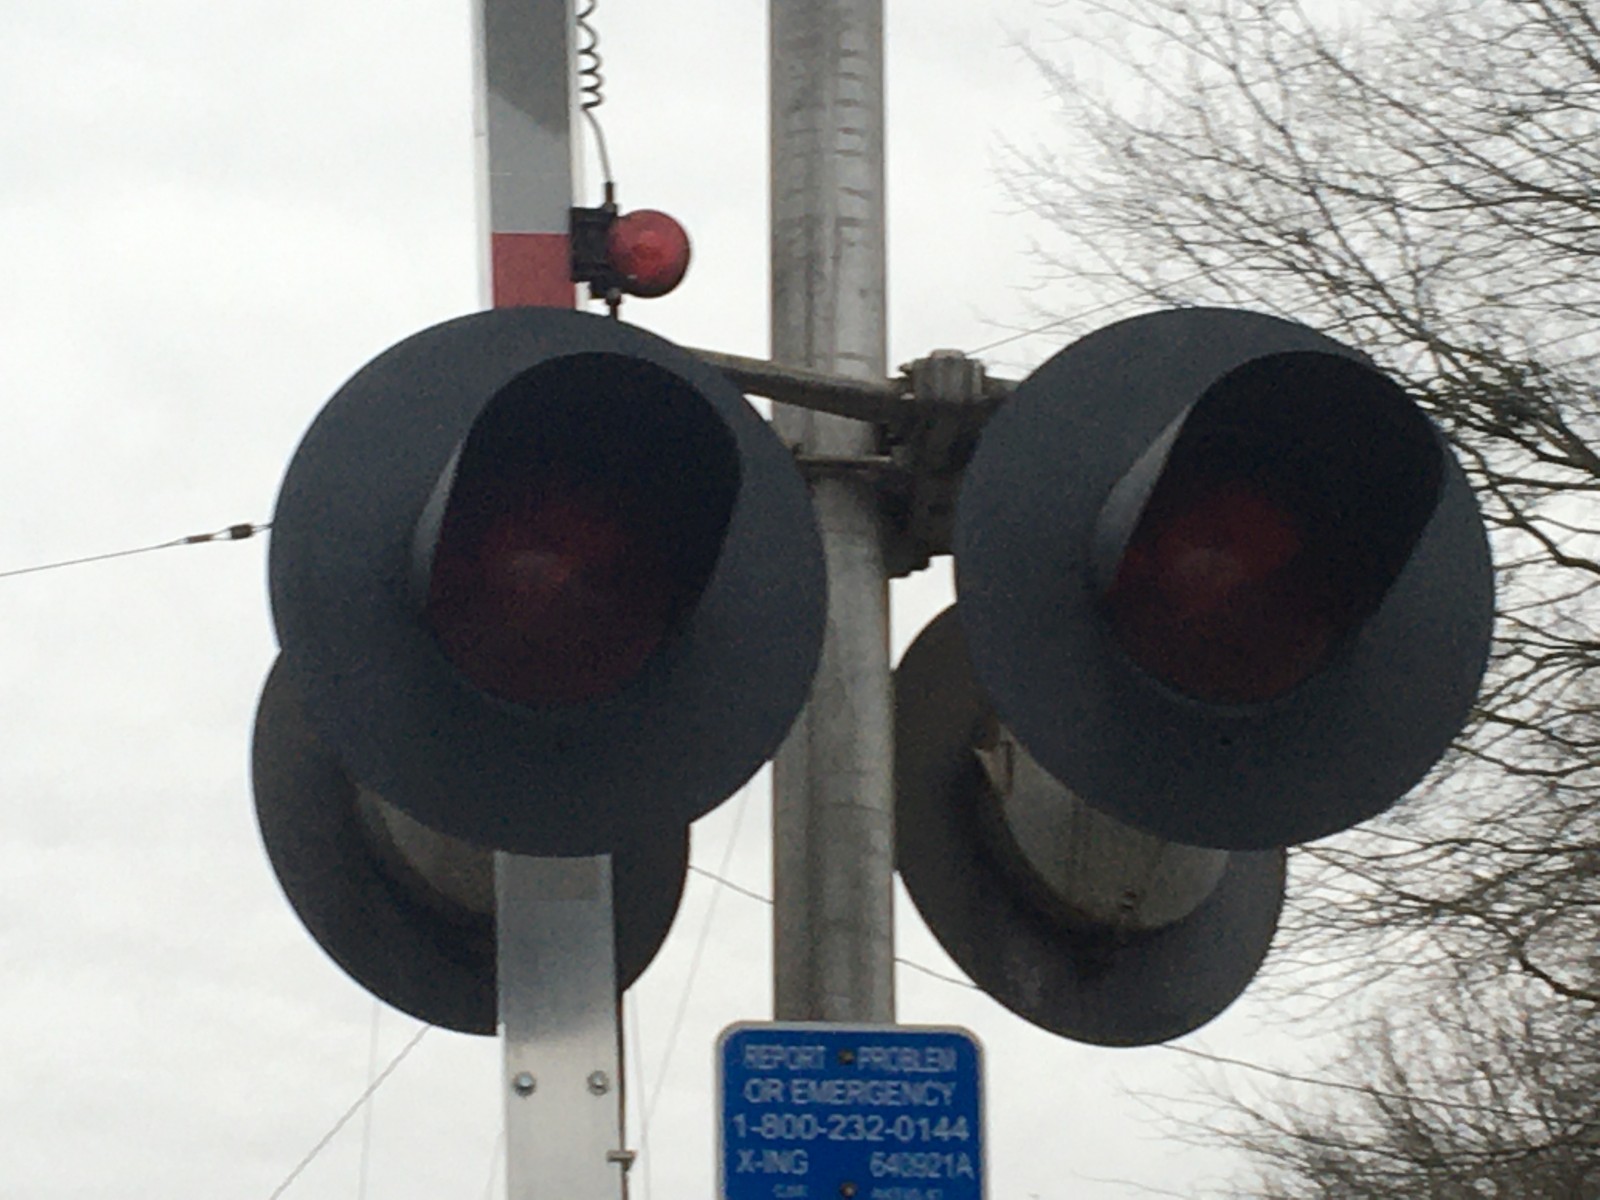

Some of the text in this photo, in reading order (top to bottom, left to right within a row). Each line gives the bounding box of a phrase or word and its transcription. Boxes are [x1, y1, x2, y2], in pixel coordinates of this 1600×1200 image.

[743, 1044, 957, 1072] REPORT PROBLEM
[743, 1078, 957, 1106] OR EMERGENCY
[732, 1114, 970, 1142] 1-800-232-0144
[735, 1149, 809, 1175] X-ING
